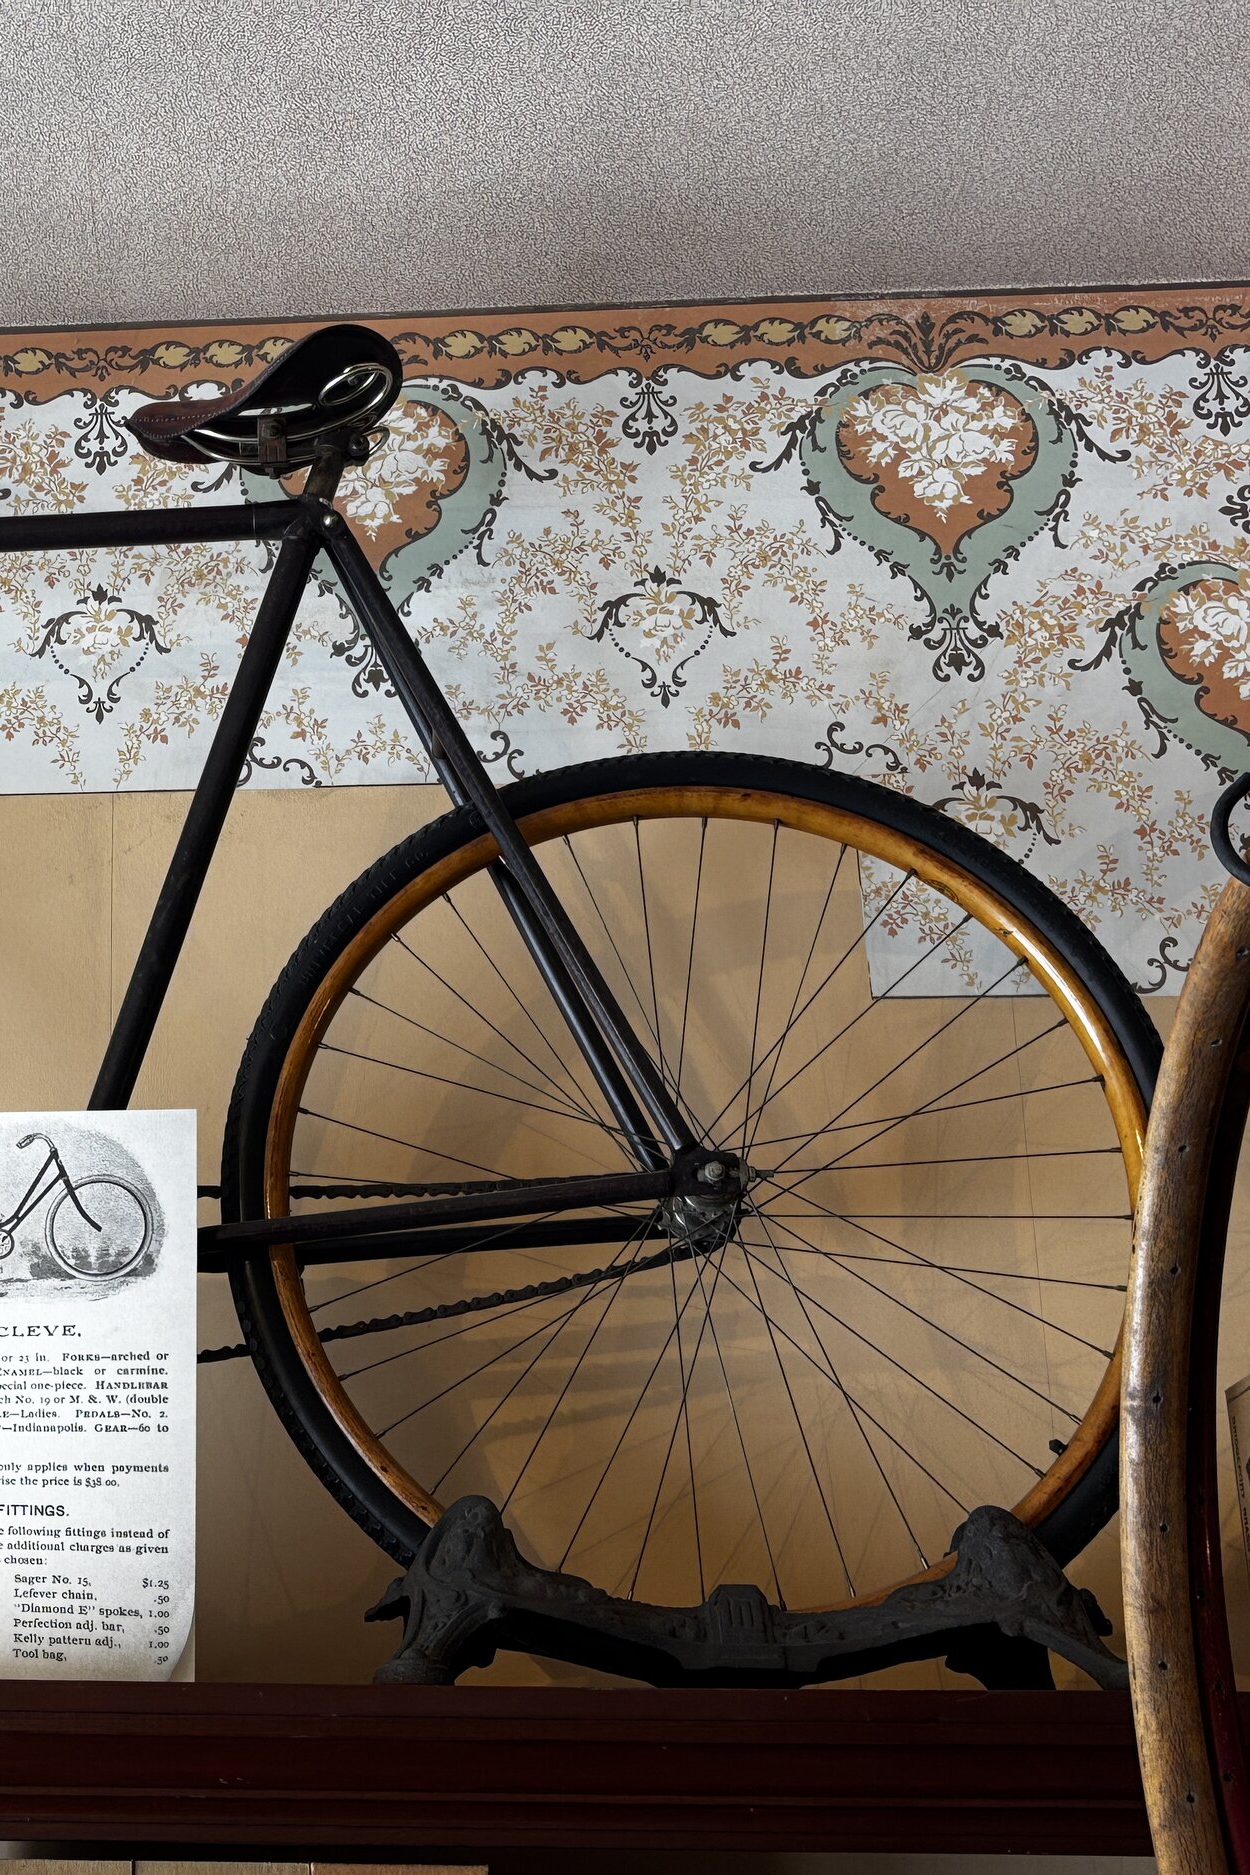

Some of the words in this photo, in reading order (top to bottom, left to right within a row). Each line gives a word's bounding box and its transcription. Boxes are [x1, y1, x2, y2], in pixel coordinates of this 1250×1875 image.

[19, 1355, 29, 1363] 23
[36, 1353, 48, 1361] in.
[117, 1365, 168, 1375] carmine.
[31, 1381, 86, 1392] one-piece.
[95, 1381, 168, 1389] HANDLEBAR
[15, 1395, 34, 1404] No.
[41, 1397, 50, 1406] 19
[106, 1395, 121, 1403] W.
[126, 1394, 169, 1405] (double
[157, 1423, 169, 1432] to
[28, 1462, 67, 1473] applies
[74, 1462, 105, 1472] when
[112, 1463, 169, 1474] payments
[20, 1476, 38, 1485] the
[42, 1477, 69, 1488] price
[73, 1476, 82, 1486] is
[8, 1526, 61, 1538] following
[65, 1527, 106, 1540] fittings
[111, 1528, 154, 1538] instead
[158, 1529, 170, 1539] of
[7, 1540, 65, 1551] additional
[70, 1542, 114, 1554] charges
[135, 1543, 169, 1555] given
[4, 1555, 47, 1565] chosen:
[14, 1574, 47, 1586] Sager
[52, 1575, 72, 1584] No.
[142, 1577, 169, 1591] $1.25
[14, 1588, 57, 1599] Lefever
[154, 1594, 170, 1605] .50
[99, 1607, 143, 1619] spokes,
[149, 1608, 171, 1619] 1.00
[13, 1618, 74, 1633] Perfection
[76, 1620, 97, 1633] adj.
[100, 1621, 124, 1634] bar,
[152, 1623, 170, 1636] .50
[13, 1631, 45, 1648] Kelly
[48, 1632, 94, 1648] pattern
[95, 1636, 121, 1649] adj.,
[149, 1641, 169, 1649] 1.00
[12, 1645, 41, 1661] Tool
[41, 1649, 67, 1663] bag,
[154, 1656, 168, 1665] .50
